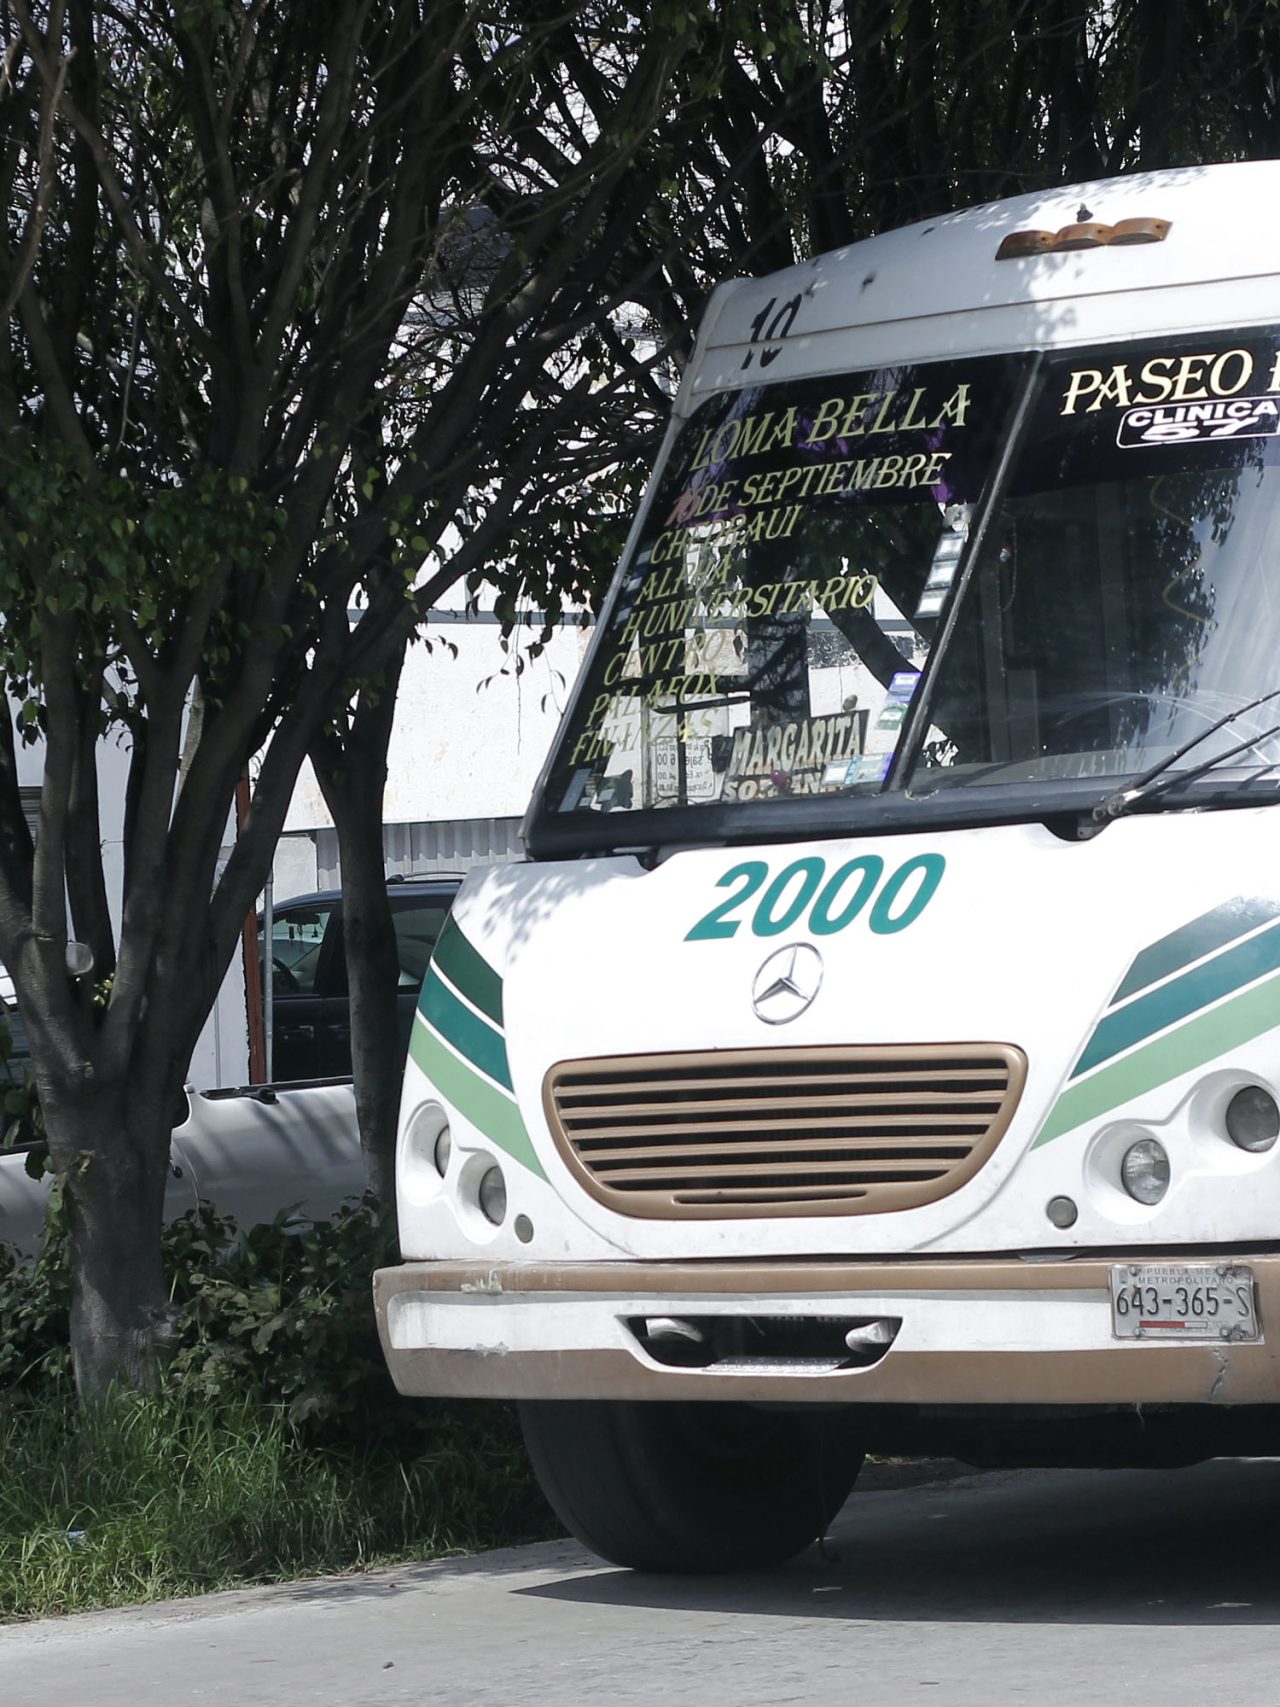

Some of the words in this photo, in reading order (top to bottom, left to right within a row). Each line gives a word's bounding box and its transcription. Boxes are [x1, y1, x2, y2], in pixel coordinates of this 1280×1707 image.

[1059, 348, 1253, 416] PASEO
[690, 407, 798, 472] LOMA
[807, 384, 971, 443] BELLA
[1127, 401, 1279, 427] CLINICA
[695, 480, 736, 517] DE
[738, 453, 952, 507] SEPTIEMBRE
[651, 505, 802, 565] CHEDRAUI
[634, 551, 732, 605] ALPHA
[604, 629, 726, 687] CENTRO
[585, 665, 726, 727] PALAFOX
[728, 712, 861, 777] MARGARITA
[682, 853, 946, 942] 2000
[1116, 1286, 1250, 1317] 643-365-S
[1138, 1276, 1234, 1285] METROPOLITANO
